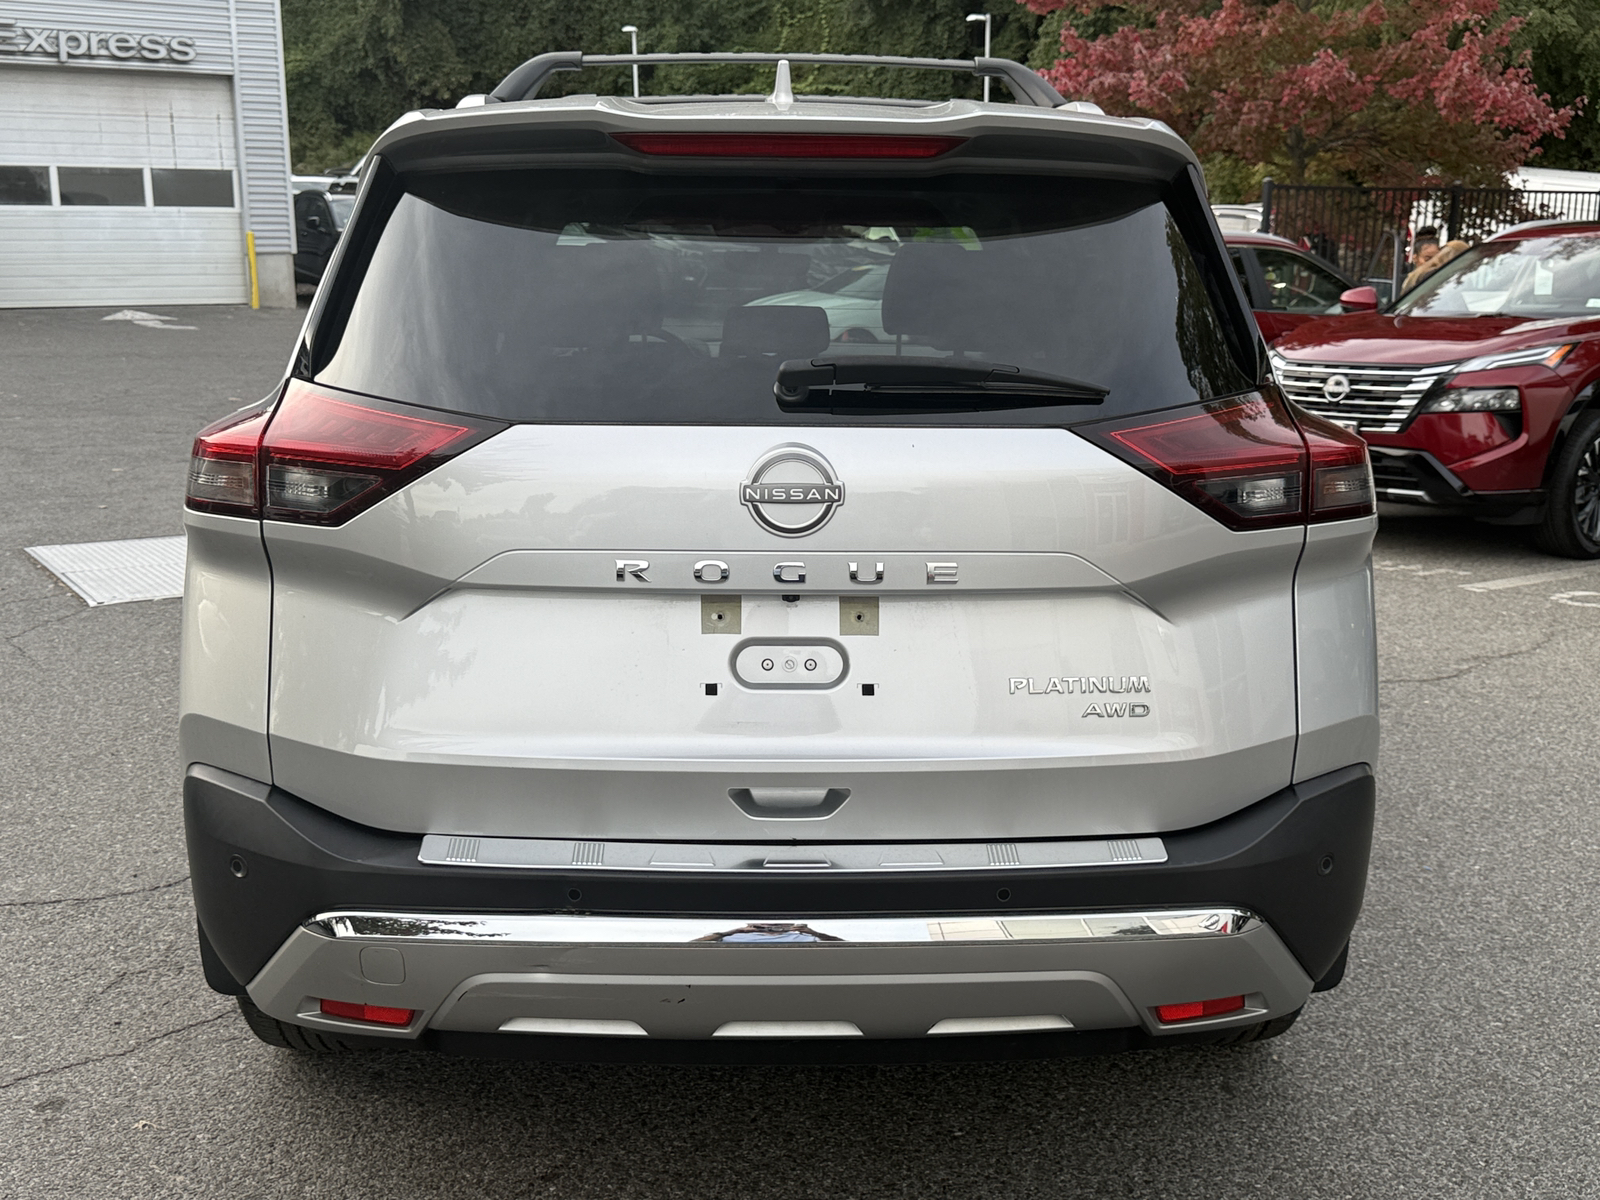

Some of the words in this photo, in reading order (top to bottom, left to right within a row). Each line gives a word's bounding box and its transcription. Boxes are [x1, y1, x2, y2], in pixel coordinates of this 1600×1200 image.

[745, 488, 839, 500] NISSAN
[614, 559, 960, 584] ROGUE
[1008, 676, 1151, 695] PLATINUM
[1081, 702, 1151, 718] AWD
